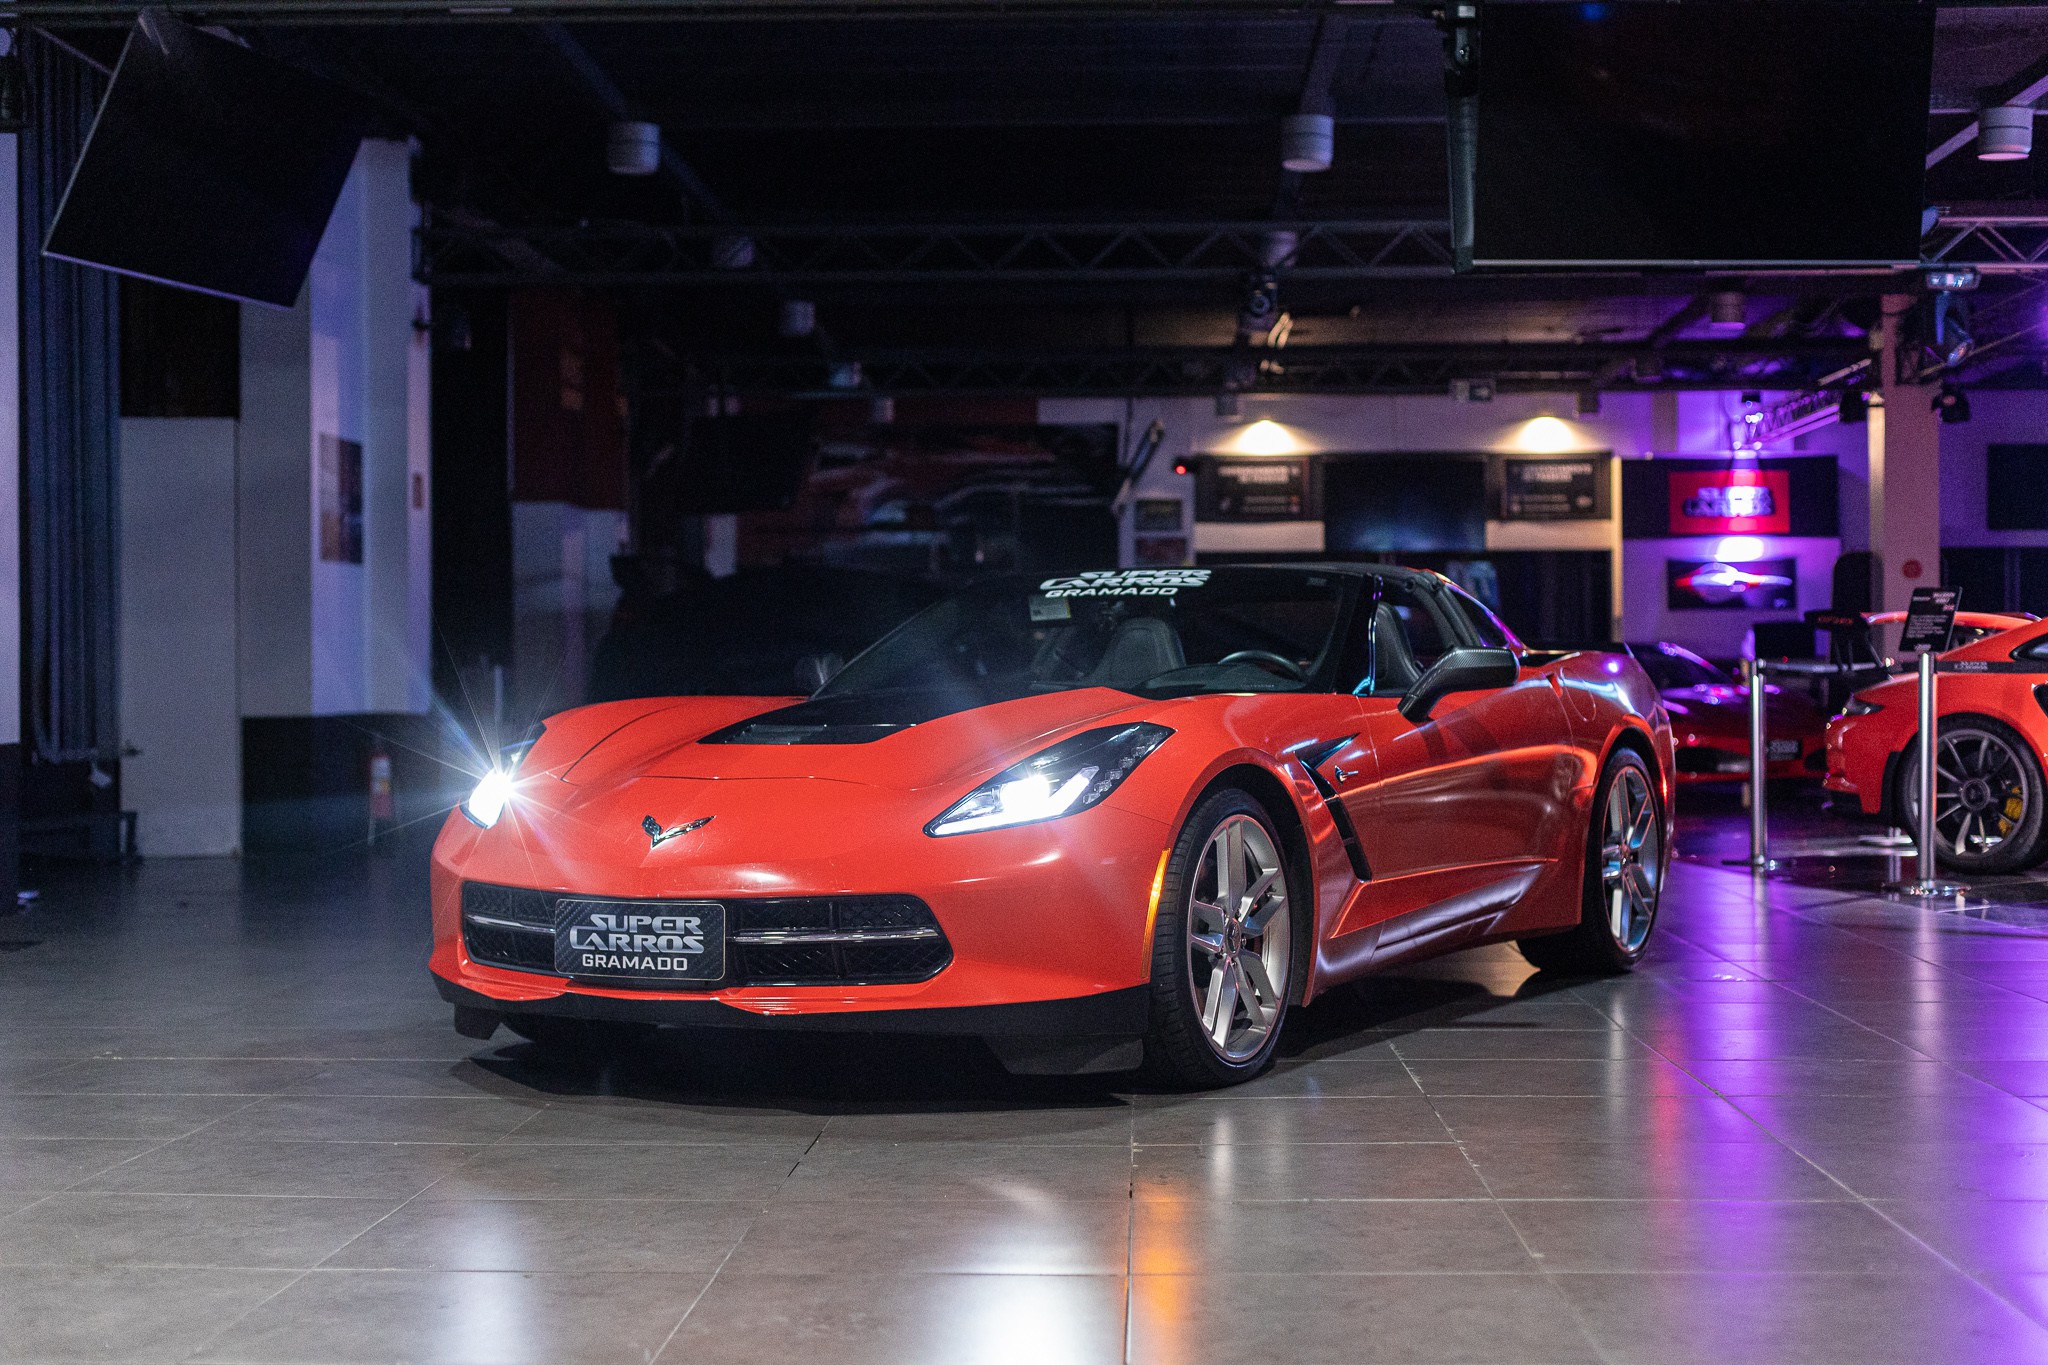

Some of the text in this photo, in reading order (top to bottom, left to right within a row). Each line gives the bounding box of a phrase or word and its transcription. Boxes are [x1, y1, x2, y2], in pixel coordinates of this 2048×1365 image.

[1079, 569, 1212, 579] SUPER
[1039, 577, 1210, 590] CARROS
[1045, 587, 1178, 598] GRAMADO
[590, 913, 704, 935] SUPER
[569, 925, 705, 954] CARROS
[582, 953, 688, 971] GRAMADO
